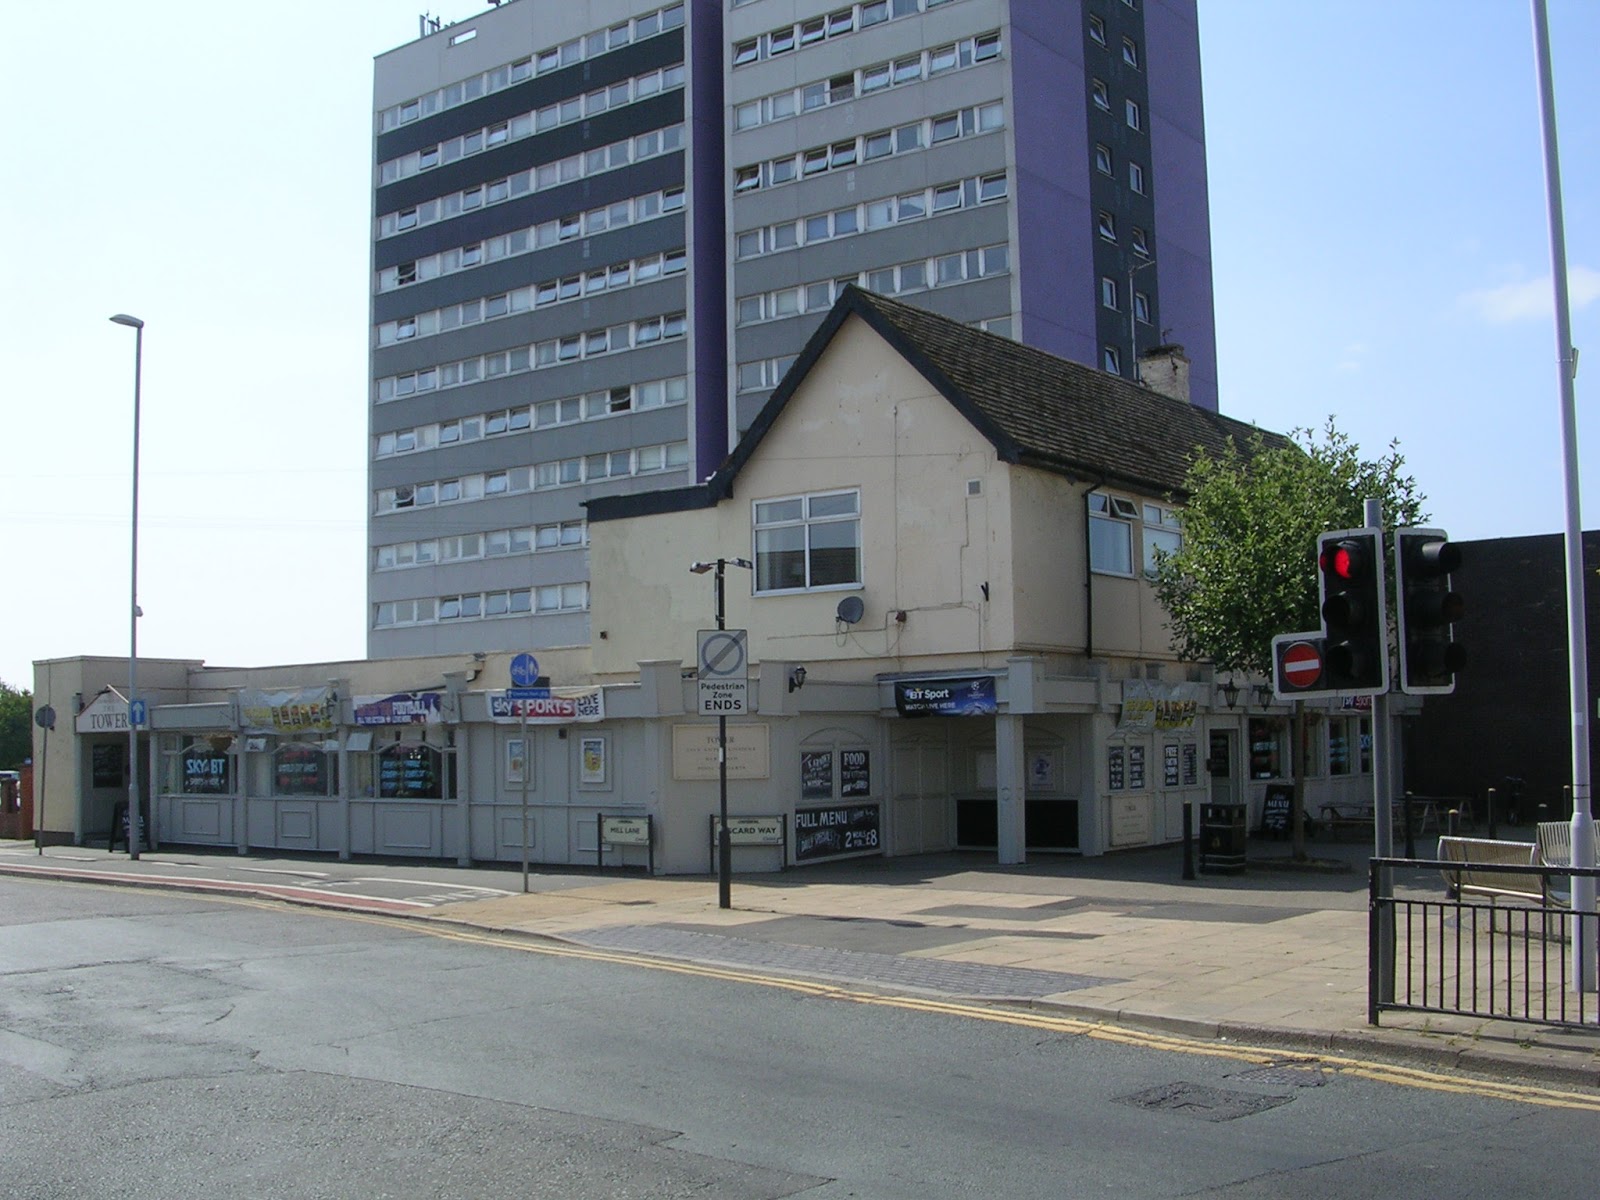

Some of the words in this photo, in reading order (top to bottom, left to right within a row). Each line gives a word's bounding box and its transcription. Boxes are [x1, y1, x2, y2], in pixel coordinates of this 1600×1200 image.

[713, 691, 733, 699] Zone
[909, 690, 923, 699] BT
[924, 688, 949, 700] Sport
[493, 698, 512, 717] sky
[517, 700, 572, 714] SPORTS
[578, 705, 600, 716] HERE
[704, 700, 742, 710] ENDS
[904, 703, 926, 711] WATCH
[940, 701, 956, 710] HERE
[90, 713, 128, 729] TOWER
[844, 752, 866, 766] FOOD
[186, 759, 208, 774] SKY
[210, 759, 225, 774] BT
[796, 813, 818, 829] FULL
[819, 810, 848, 827] MENU
[845, 831, 853, 849] 2
